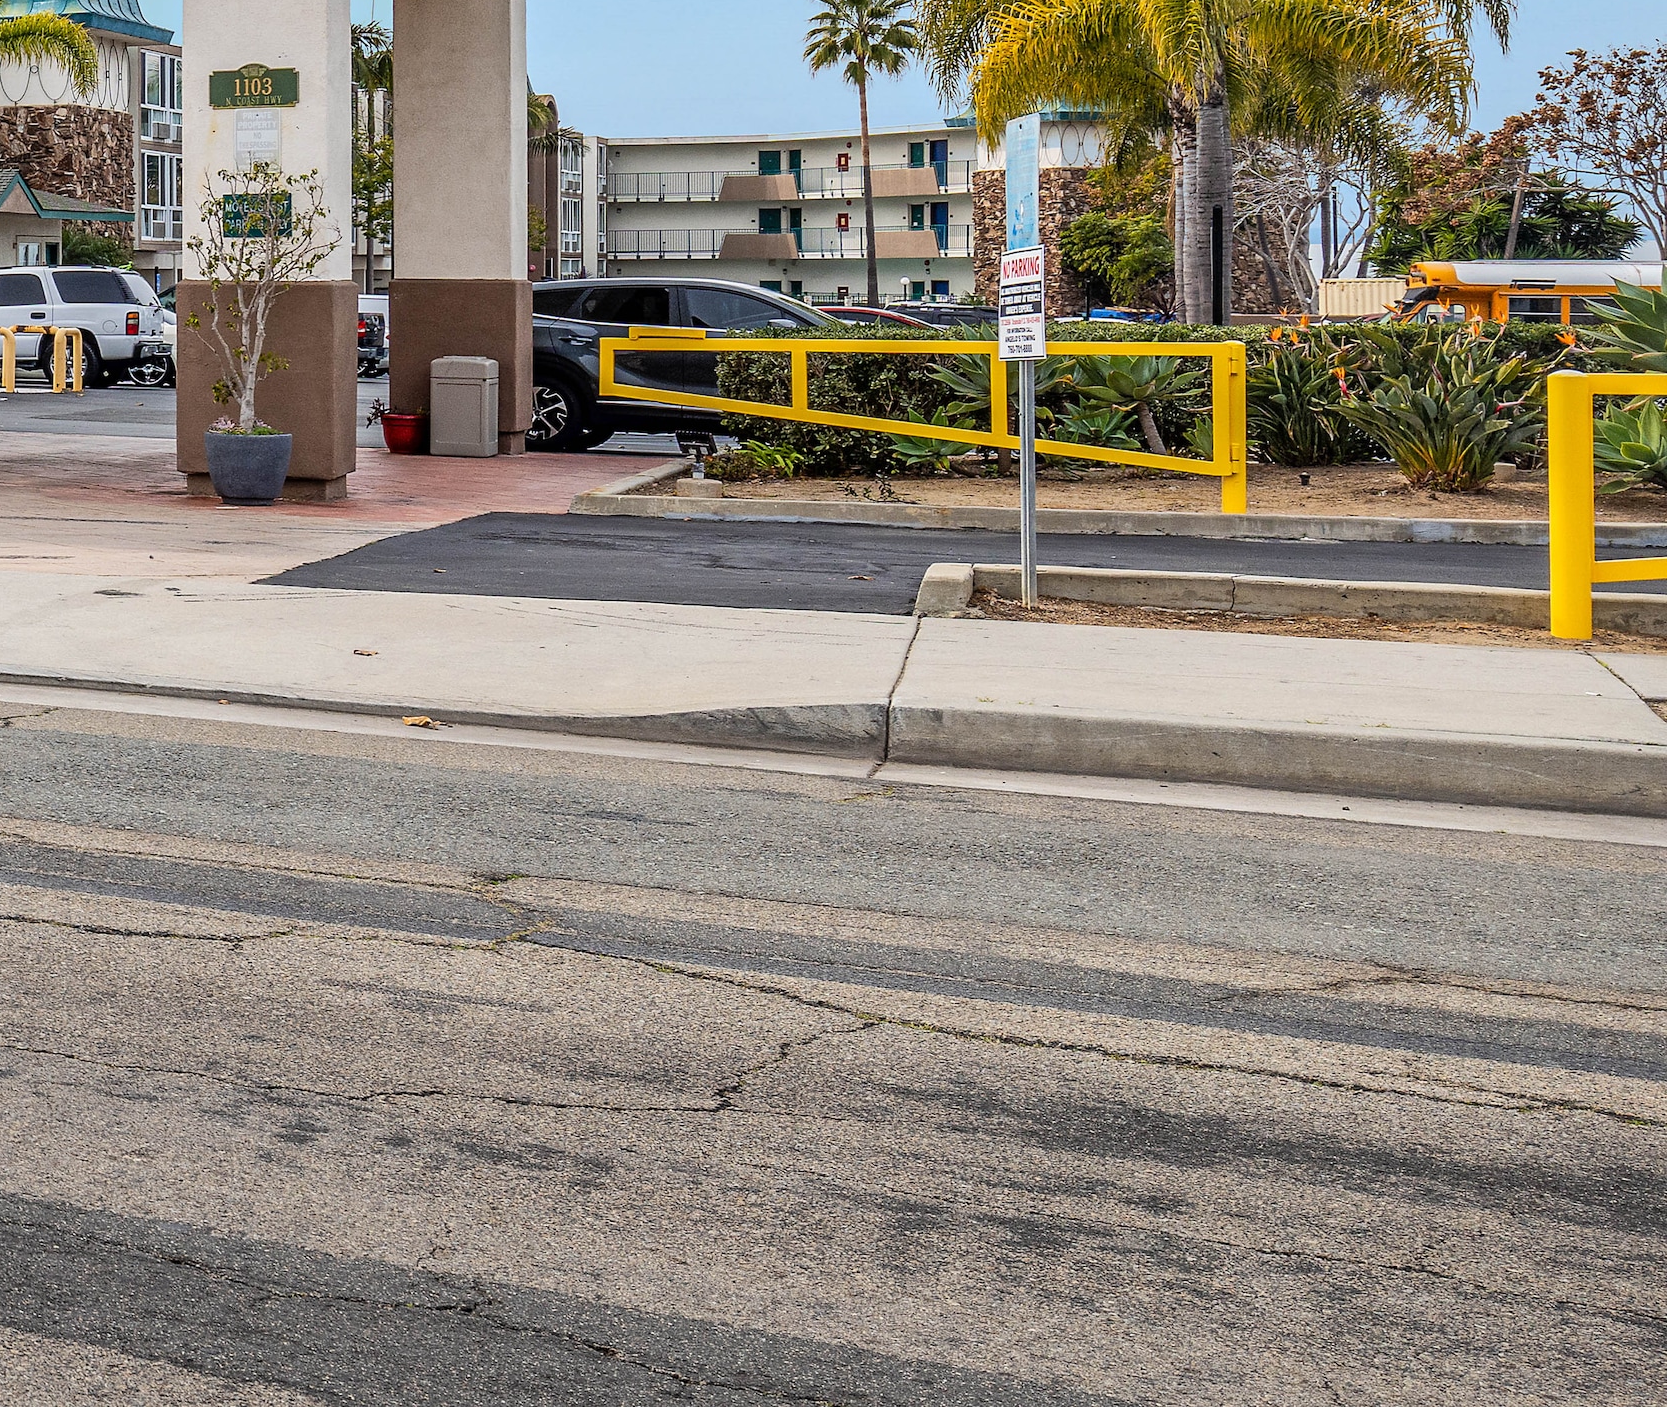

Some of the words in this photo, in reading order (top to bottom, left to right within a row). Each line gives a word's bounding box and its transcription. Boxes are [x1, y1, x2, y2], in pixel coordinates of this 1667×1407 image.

[234, 77, 273, 96] 1103
[225, 97, 232, 105] N
[237, 96, 260, 105] COAST
[264, 95, 283, 104] HWY
[1003, 260, 1010, 279] NO
[1011, 255, 1040, 278] PARKING
